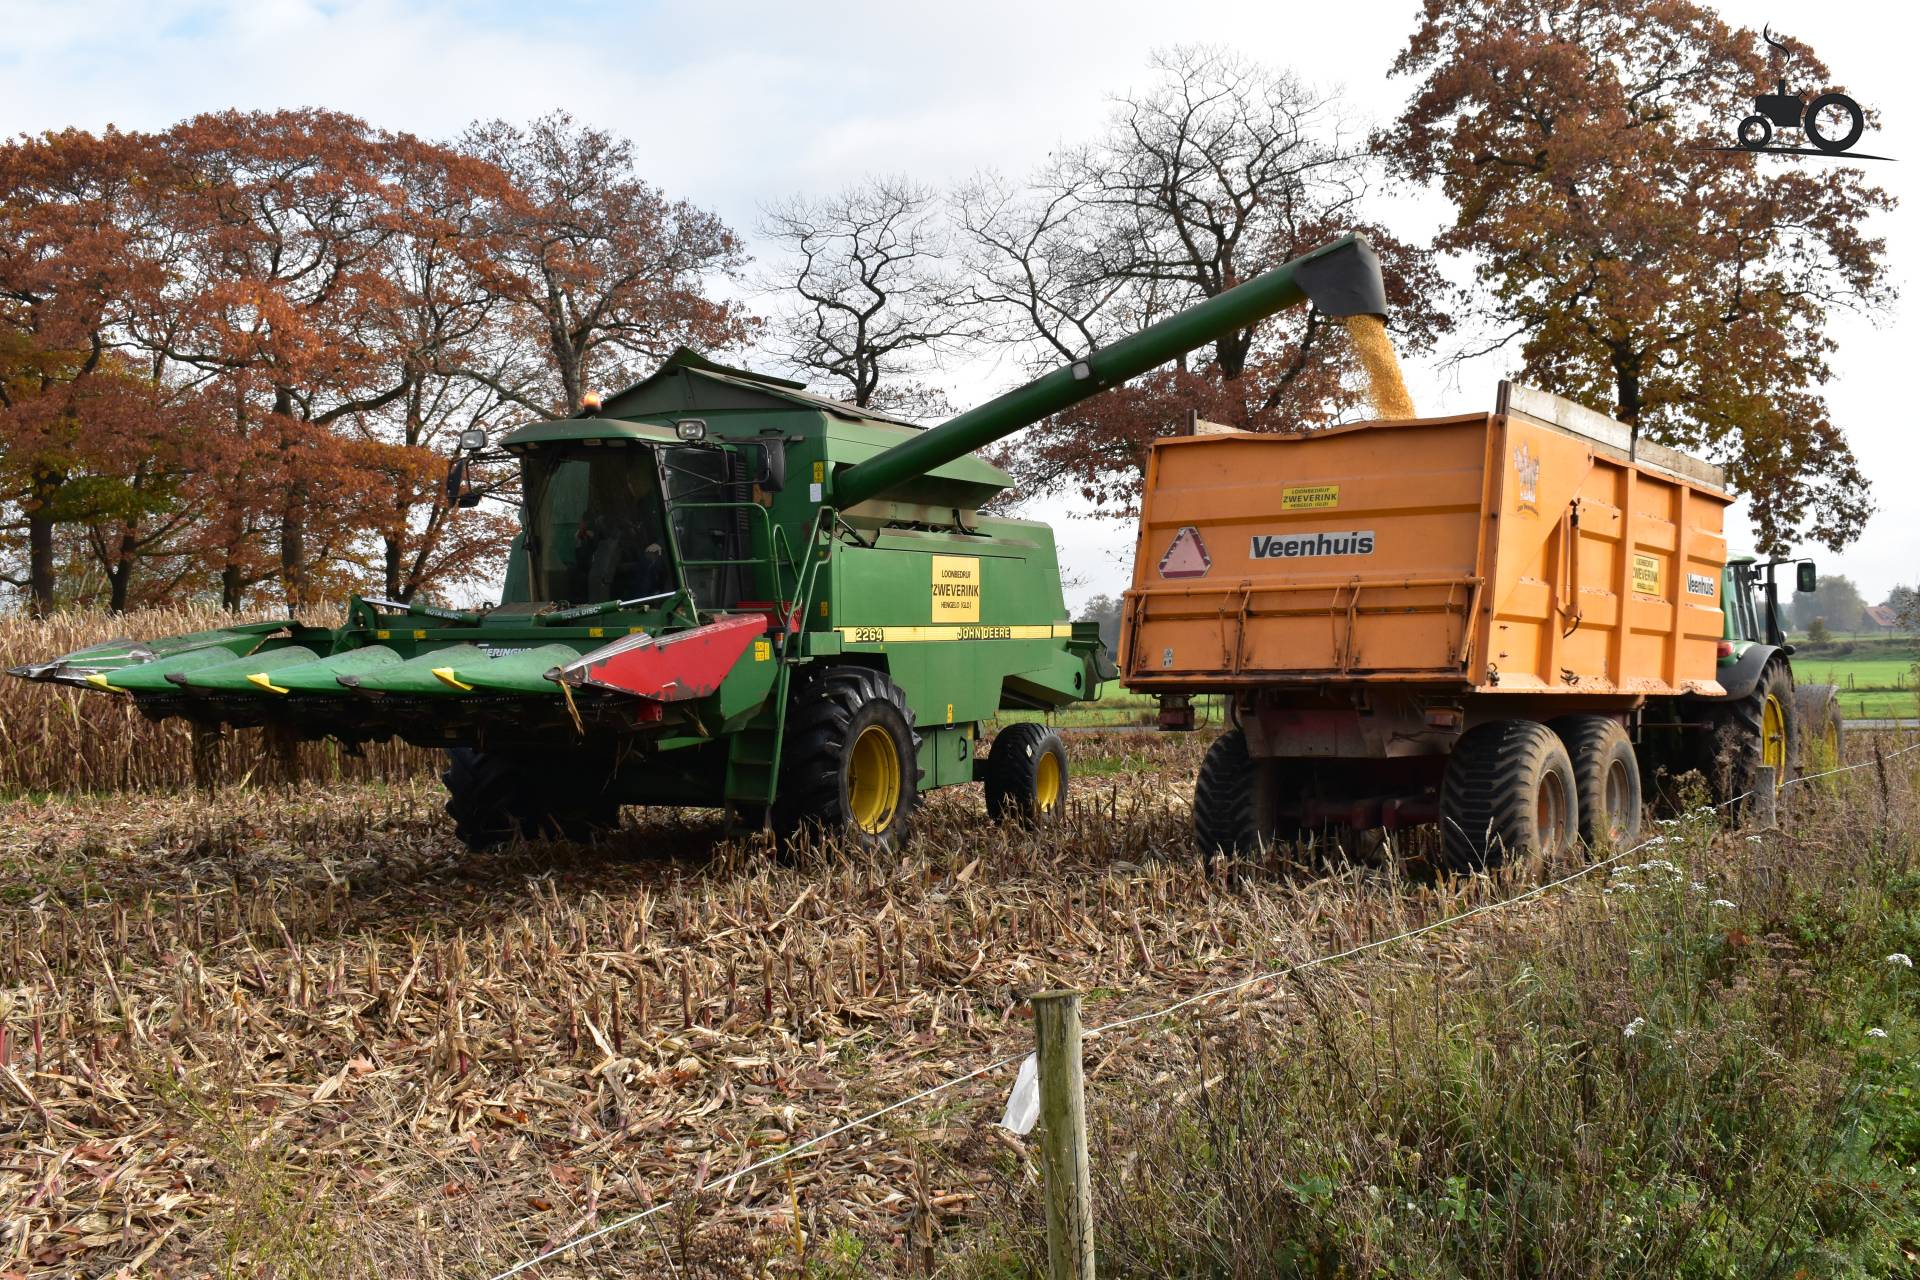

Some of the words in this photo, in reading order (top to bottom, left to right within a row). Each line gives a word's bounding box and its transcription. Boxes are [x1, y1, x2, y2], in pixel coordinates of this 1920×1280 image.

[1283, 494, 1337, 503] ZWEVERINK
[1252, 532, 1373, 558] Veenhuis
[933, 584, 979, 597] ZWEVERINK
[1686, 573, 1714, 596] Veenhuis
[581, 606, 600, 615] DISC
[856, 628, 883, 642] 2264
[957, 627, 981, 640] JOHN
[983, 627, 1010, 639] DEERE
